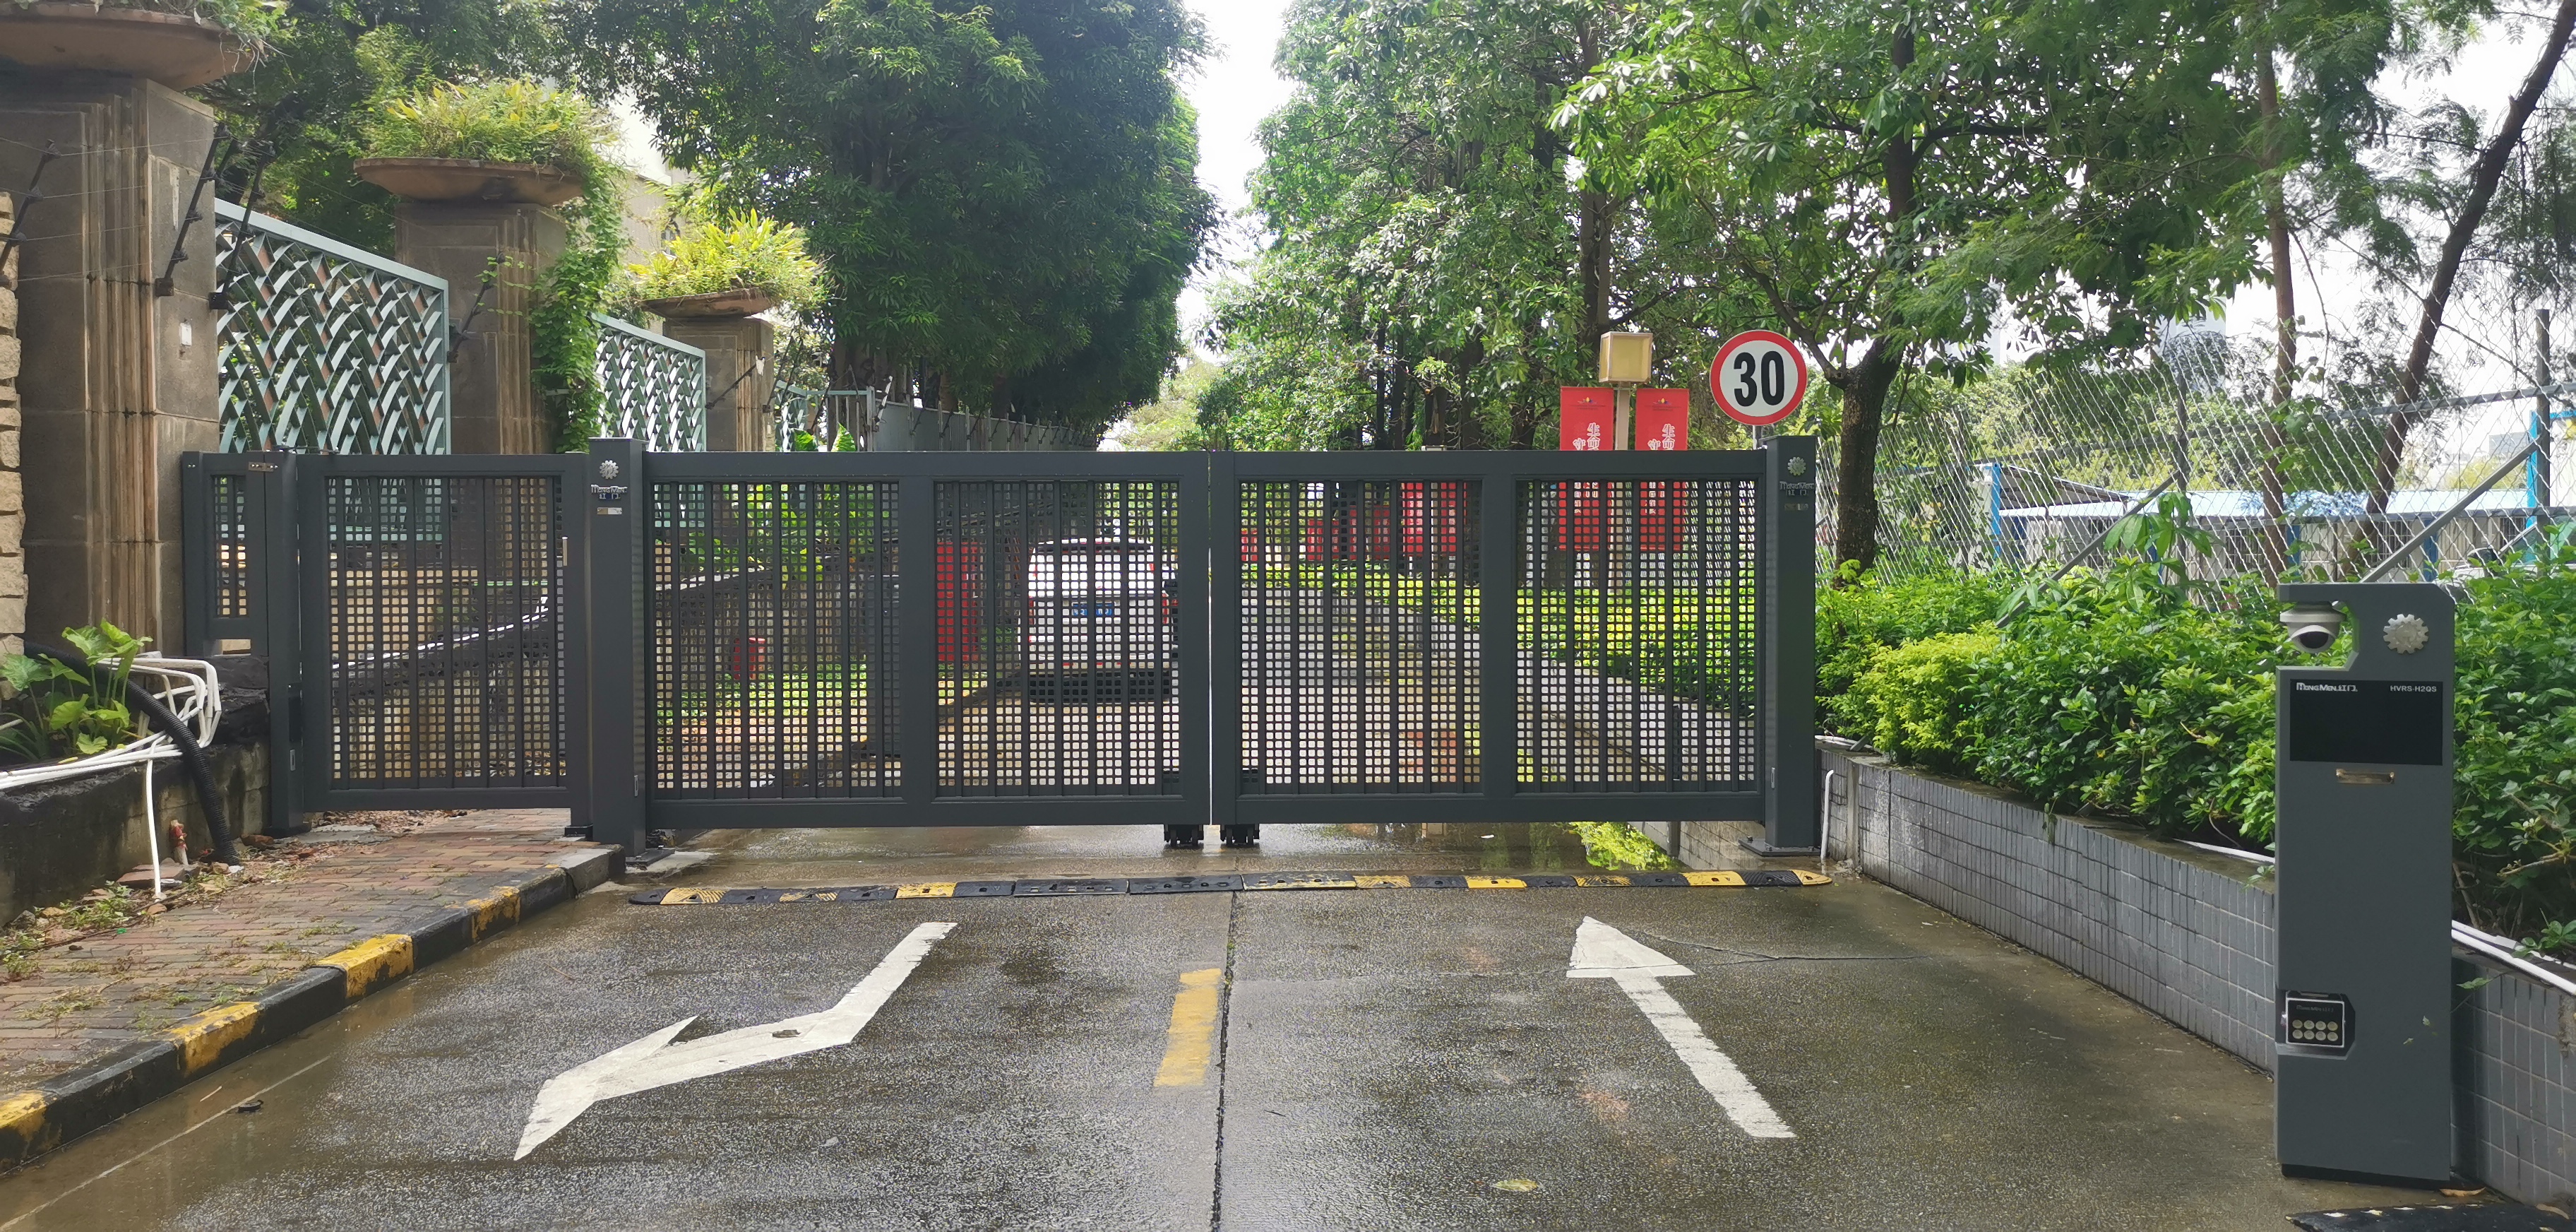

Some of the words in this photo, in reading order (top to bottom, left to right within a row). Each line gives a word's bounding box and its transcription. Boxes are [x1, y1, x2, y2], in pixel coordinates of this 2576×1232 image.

[1733, 350, 1785, 407] 30
[1587, 422, 1601, 451] 生命
[1662, 423, 1676, 451] 生命
